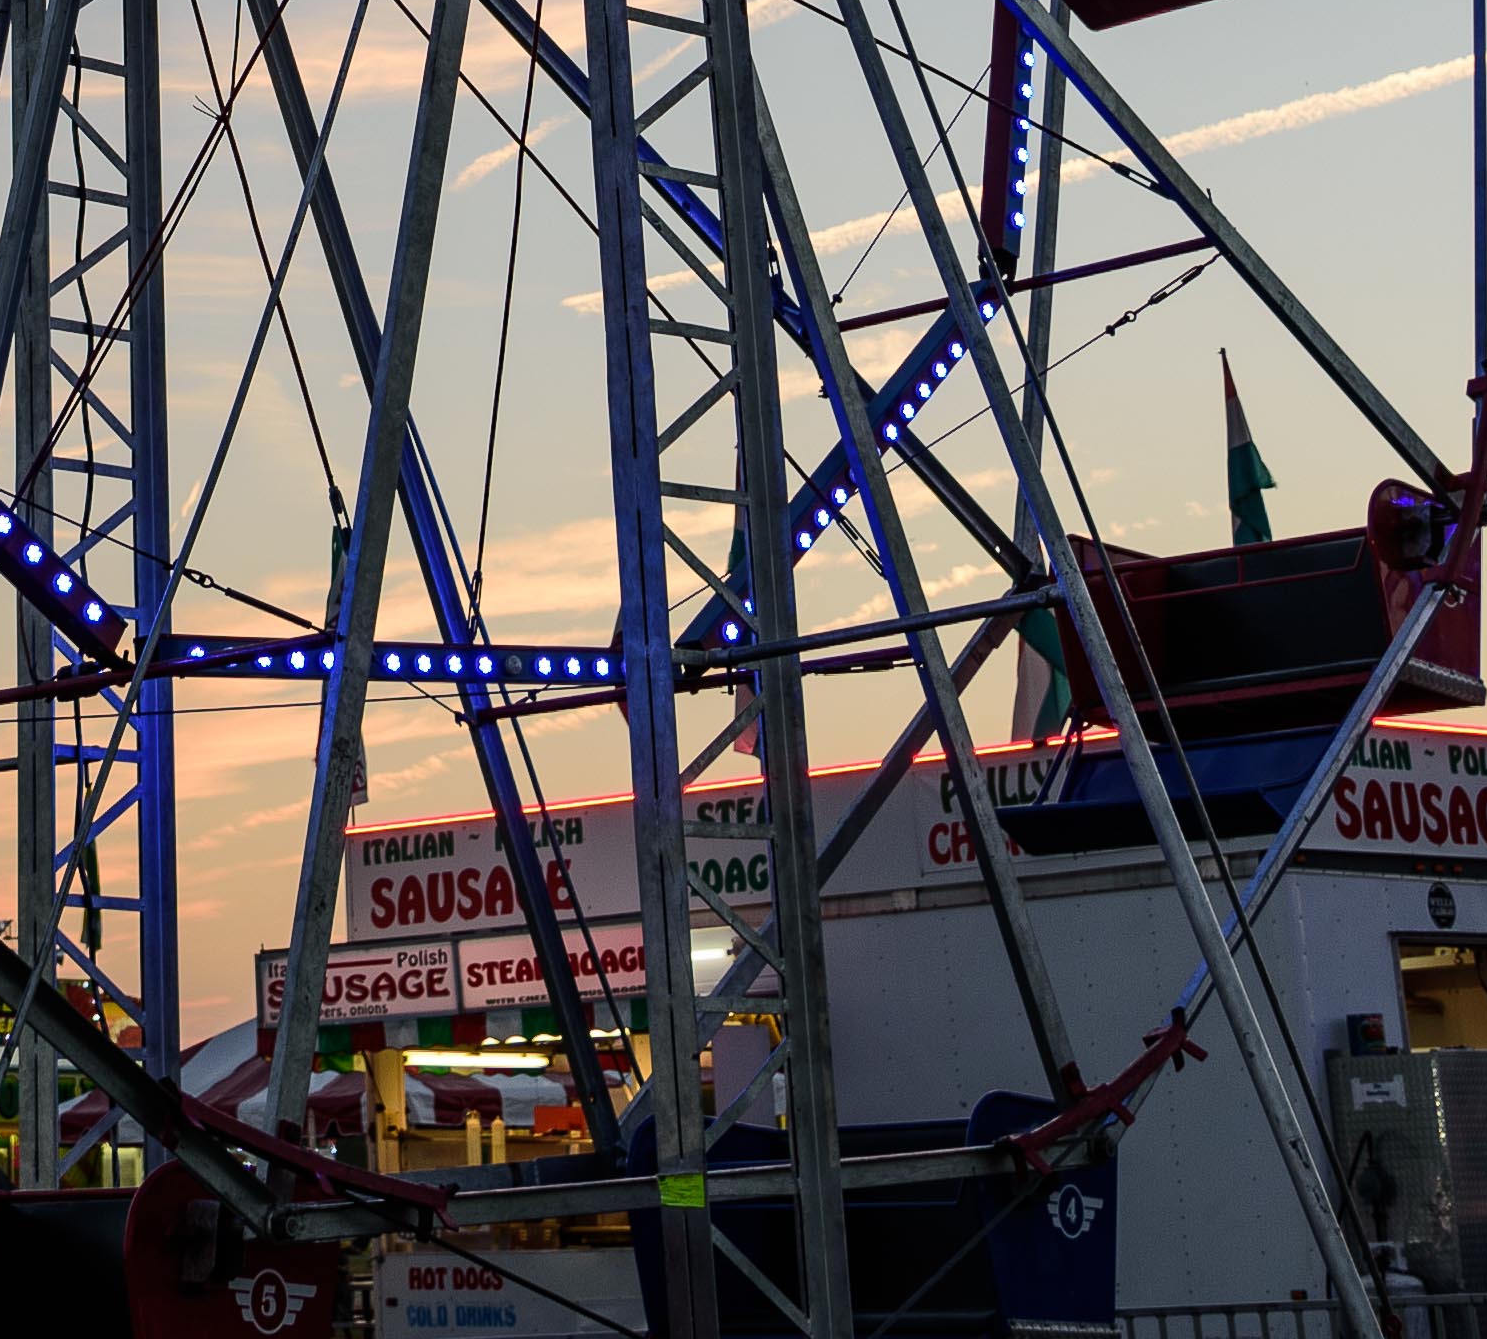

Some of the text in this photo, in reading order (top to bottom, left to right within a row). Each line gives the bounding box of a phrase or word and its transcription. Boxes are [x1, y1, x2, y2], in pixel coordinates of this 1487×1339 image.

[1348, 737, 1412, 771] LIAN
[363, 830, 454, 866] ITALIAN
[371, 859, 572, 929] SAUSAE
[397, 948, 448, 968] Polish
[268, 967, 450, 1011] SUSAGE
[350, 1003, 389, 1017] onions
[1066, 1196, 1077, 1224] 4
[409, 1266, 504, 1291] HOT DOGS
[260, 1283, 277, 1317] 5
[407, 1304, 517, 1328] COLD DRINKS
